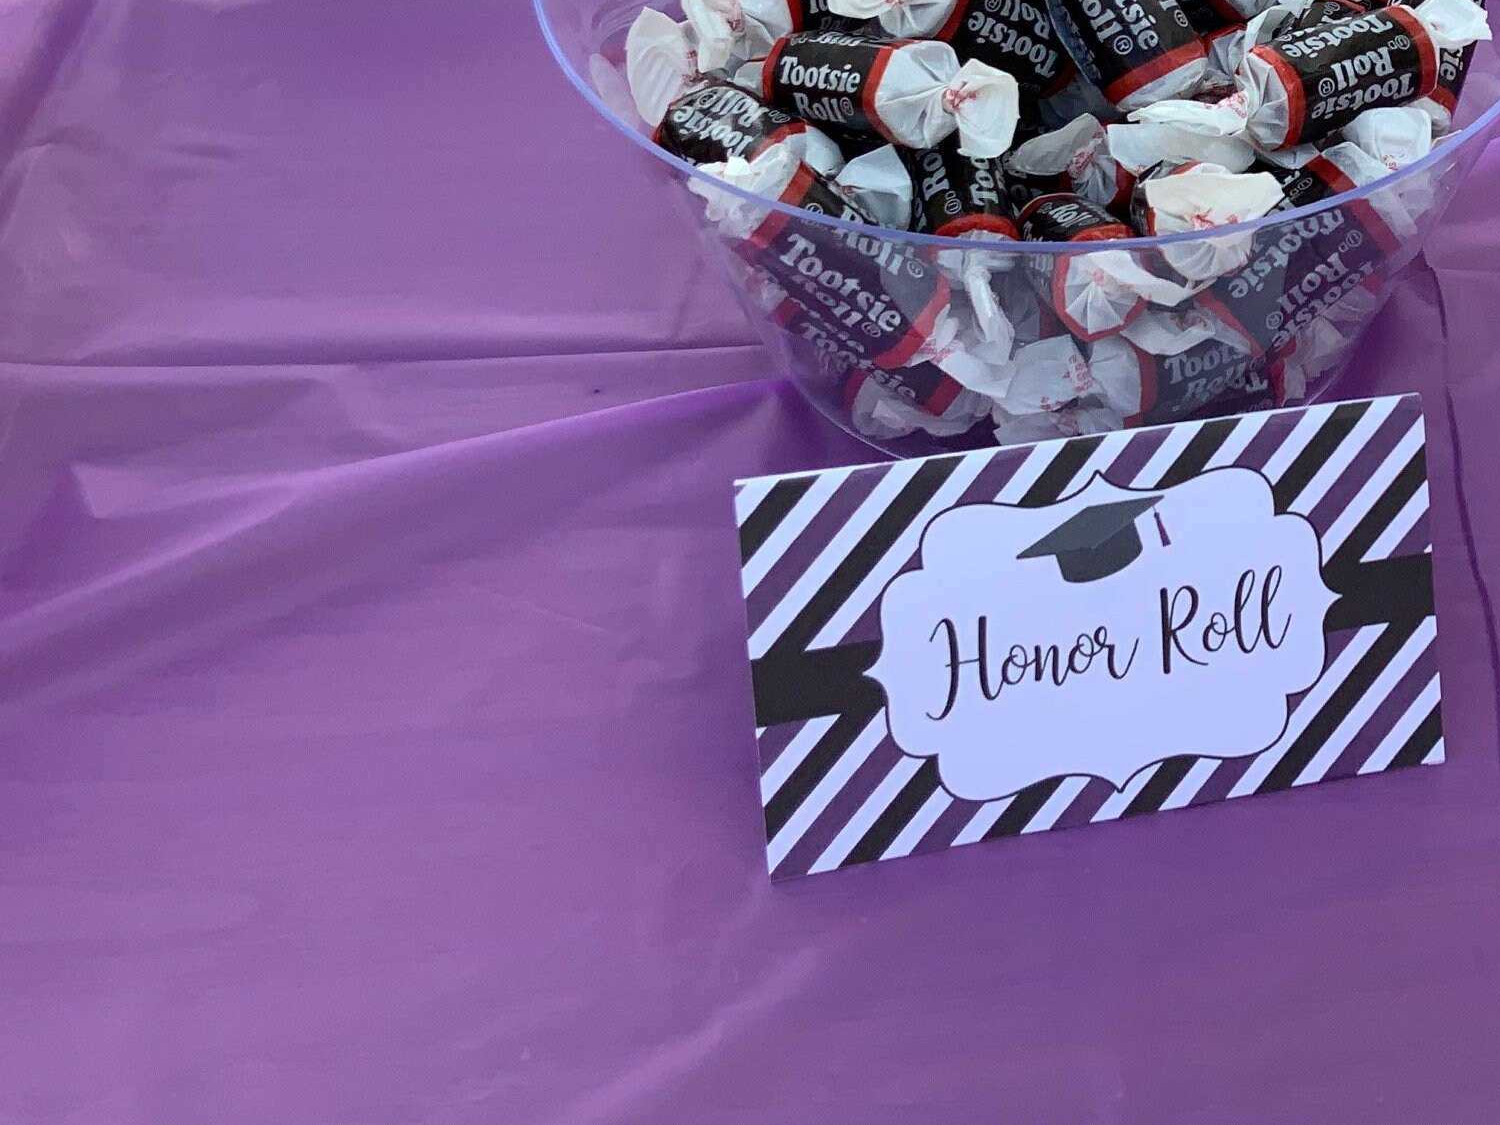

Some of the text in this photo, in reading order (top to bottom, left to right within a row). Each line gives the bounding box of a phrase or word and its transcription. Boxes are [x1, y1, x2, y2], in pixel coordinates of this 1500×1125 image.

[968, 9, 1060, 79] Tootsie
[1283, 12, 1394, 59] Tootsie
[779, 54, 862, 95] Tootsie
[1310, 71, 1416, 121] Tootsie
[672, 104, 757, 160] Tootsie
[779, 232, 903, 333] Tootsie
[1227, 209, 1346, 301] Tootsie
[1164, 343, 1252, 386] Toots
[926, 565, 1293, 721] Honor Roll
